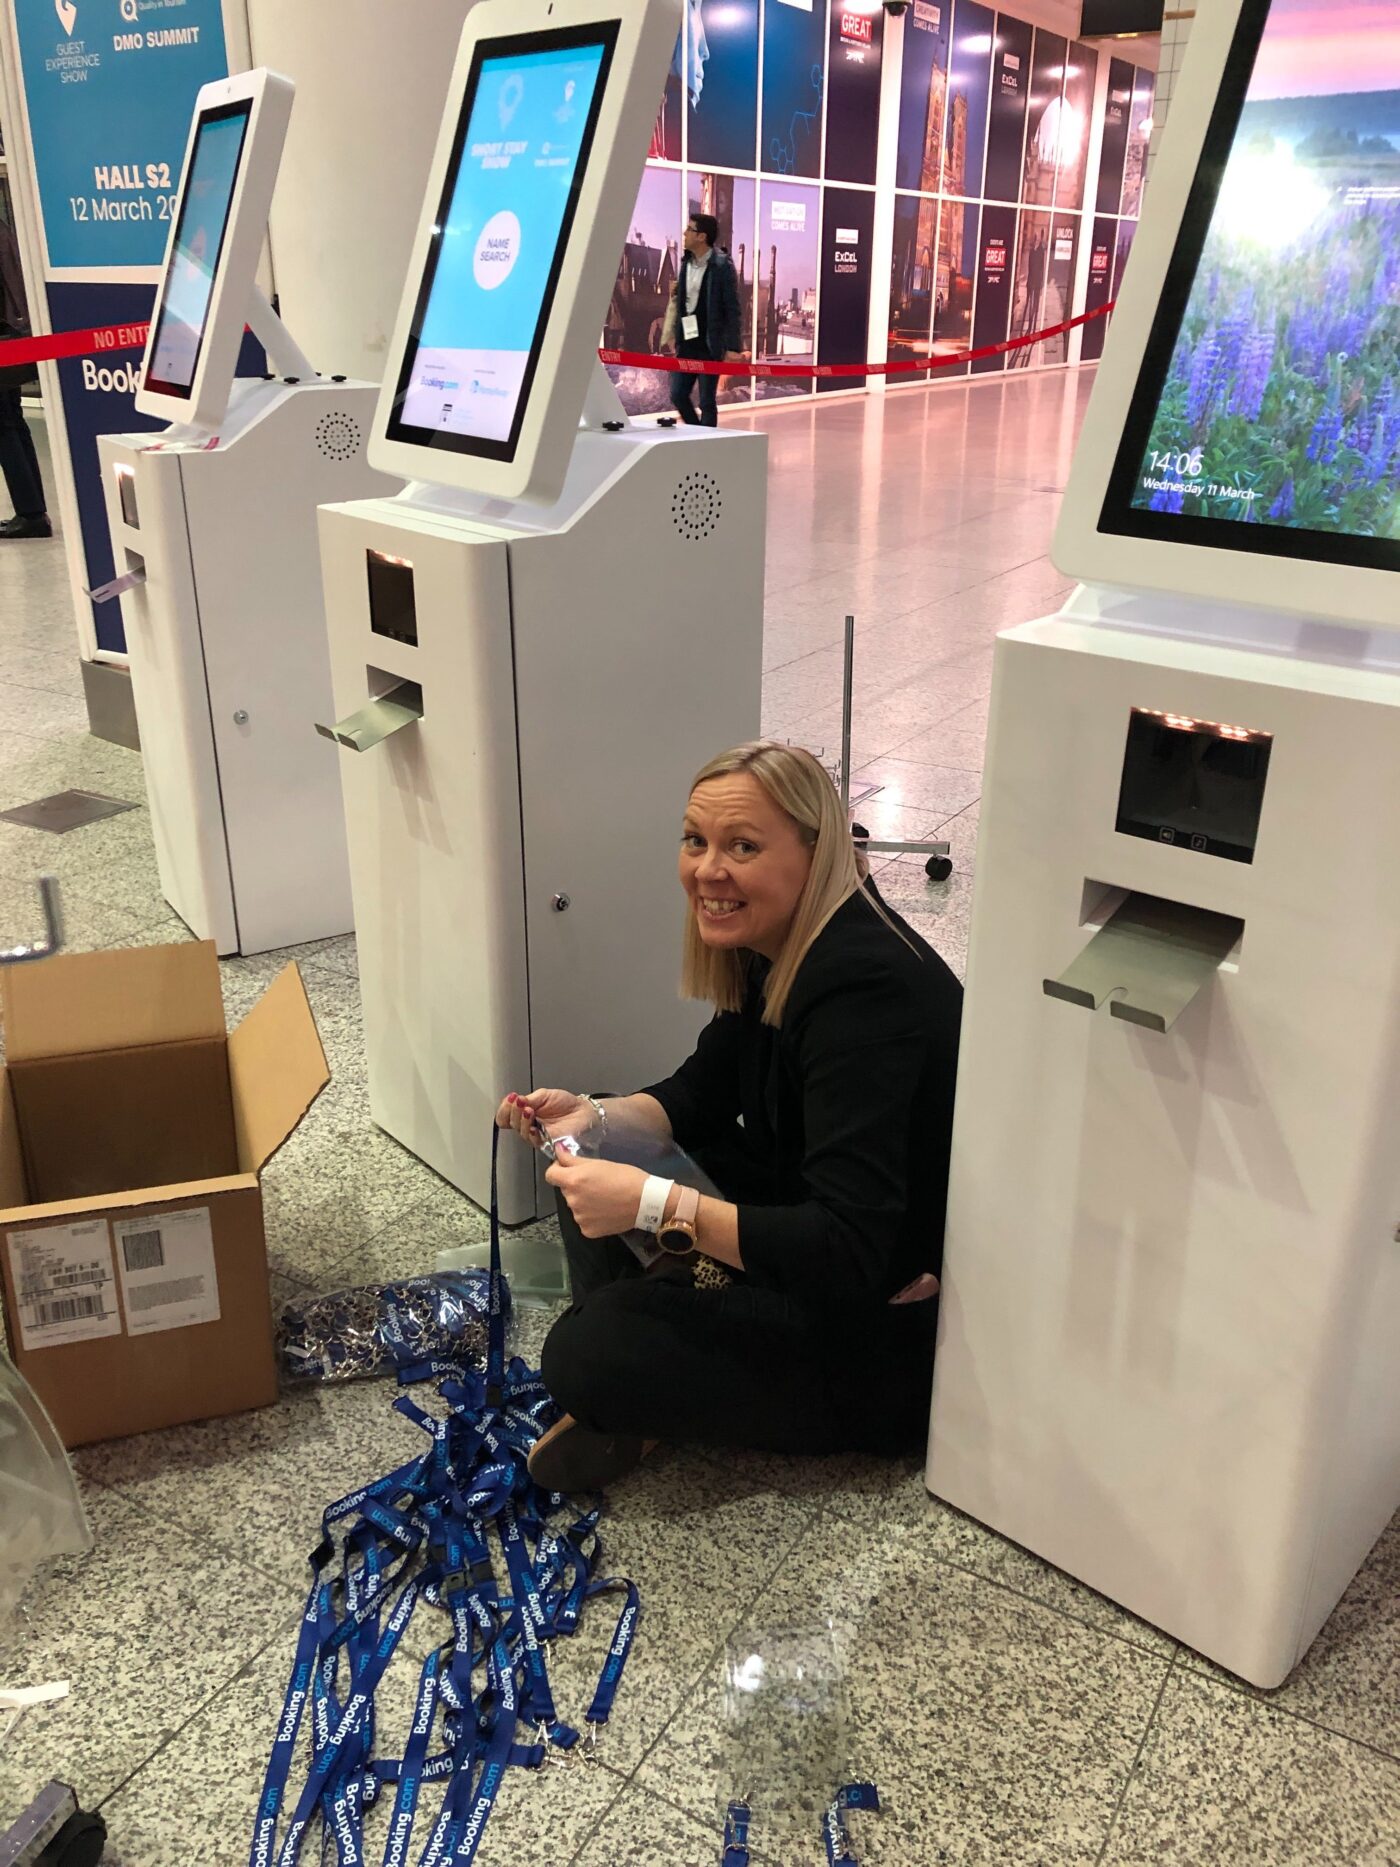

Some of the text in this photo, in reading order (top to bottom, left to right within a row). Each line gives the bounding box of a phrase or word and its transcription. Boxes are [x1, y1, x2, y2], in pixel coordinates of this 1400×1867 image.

[842, 14, 871, 38] GREAT
[55, 41, 86, 56] GUEST
[113, 27, 200, 51] DMO SUMMIT
[45, 54, 100, 71] EXPERIENCE
[60, 70, 88, 83] SHOW
[94, 162, 171, 189] HALL S2
[70, 197, 88, 221] 12
[91, 196, 152, 221] March
[487, 238, 510, 249] NAME
[480, 250, 511, 262] SEARCH
[985, 249, 1005, 264] GREAT
[834, 263, 858, 274] LONDON
[93, 330, 115, 350] NO
[601, 349, 622, 363] ENTRY
[687, 359, 705, 371] ENTRY
[82, 359, 143, 393] Book
[1150, 450, 1204, 476] 14:06
[1143, 477, 1256, 500] Wednesday 11 March
[510, 1382, 546, 1396] ooking
[377, 1582, 418, 1658] Booking.com
[604, 1606, 637, 1682] Booking.com
[278, 1662, 309, 1743] Booking.com
[316, 1693, 367, 1775] Booking.com
[457, 1762, 500, 1856] Booking.com
[254, 1786, 280, 1867] ooking.com
